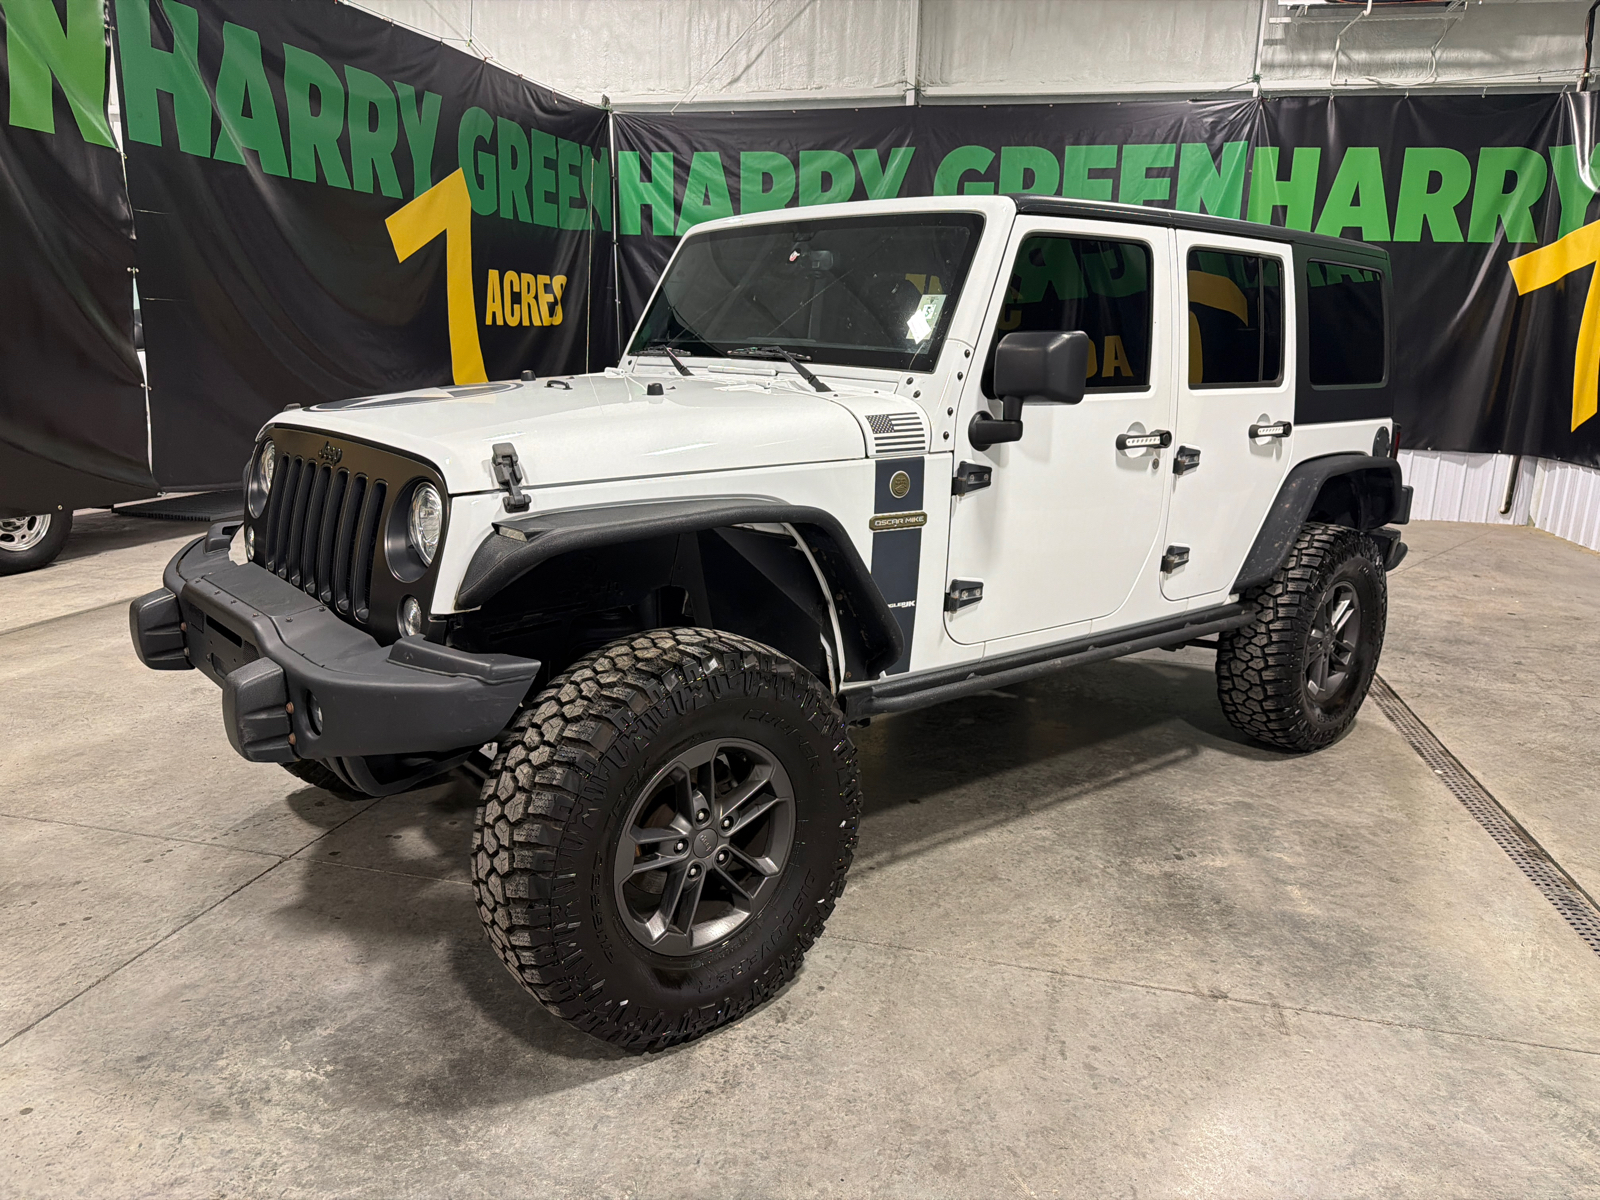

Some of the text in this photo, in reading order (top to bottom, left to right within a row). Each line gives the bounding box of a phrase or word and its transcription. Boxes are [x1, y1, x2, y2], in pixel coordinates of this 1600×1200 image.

[1, 0, 116, 149] N
[115, 0, 612, 232] HARRY GREEN
[617, 141, 1248, 237] HARRY GREEN
[1246, 144, 1600, 244] HARRY
[386, 167, 568, 384] 7 ACRES
[1507, 219, 1600, 432] 7
[874, 515, 925, 527] OSCAR MIKE
